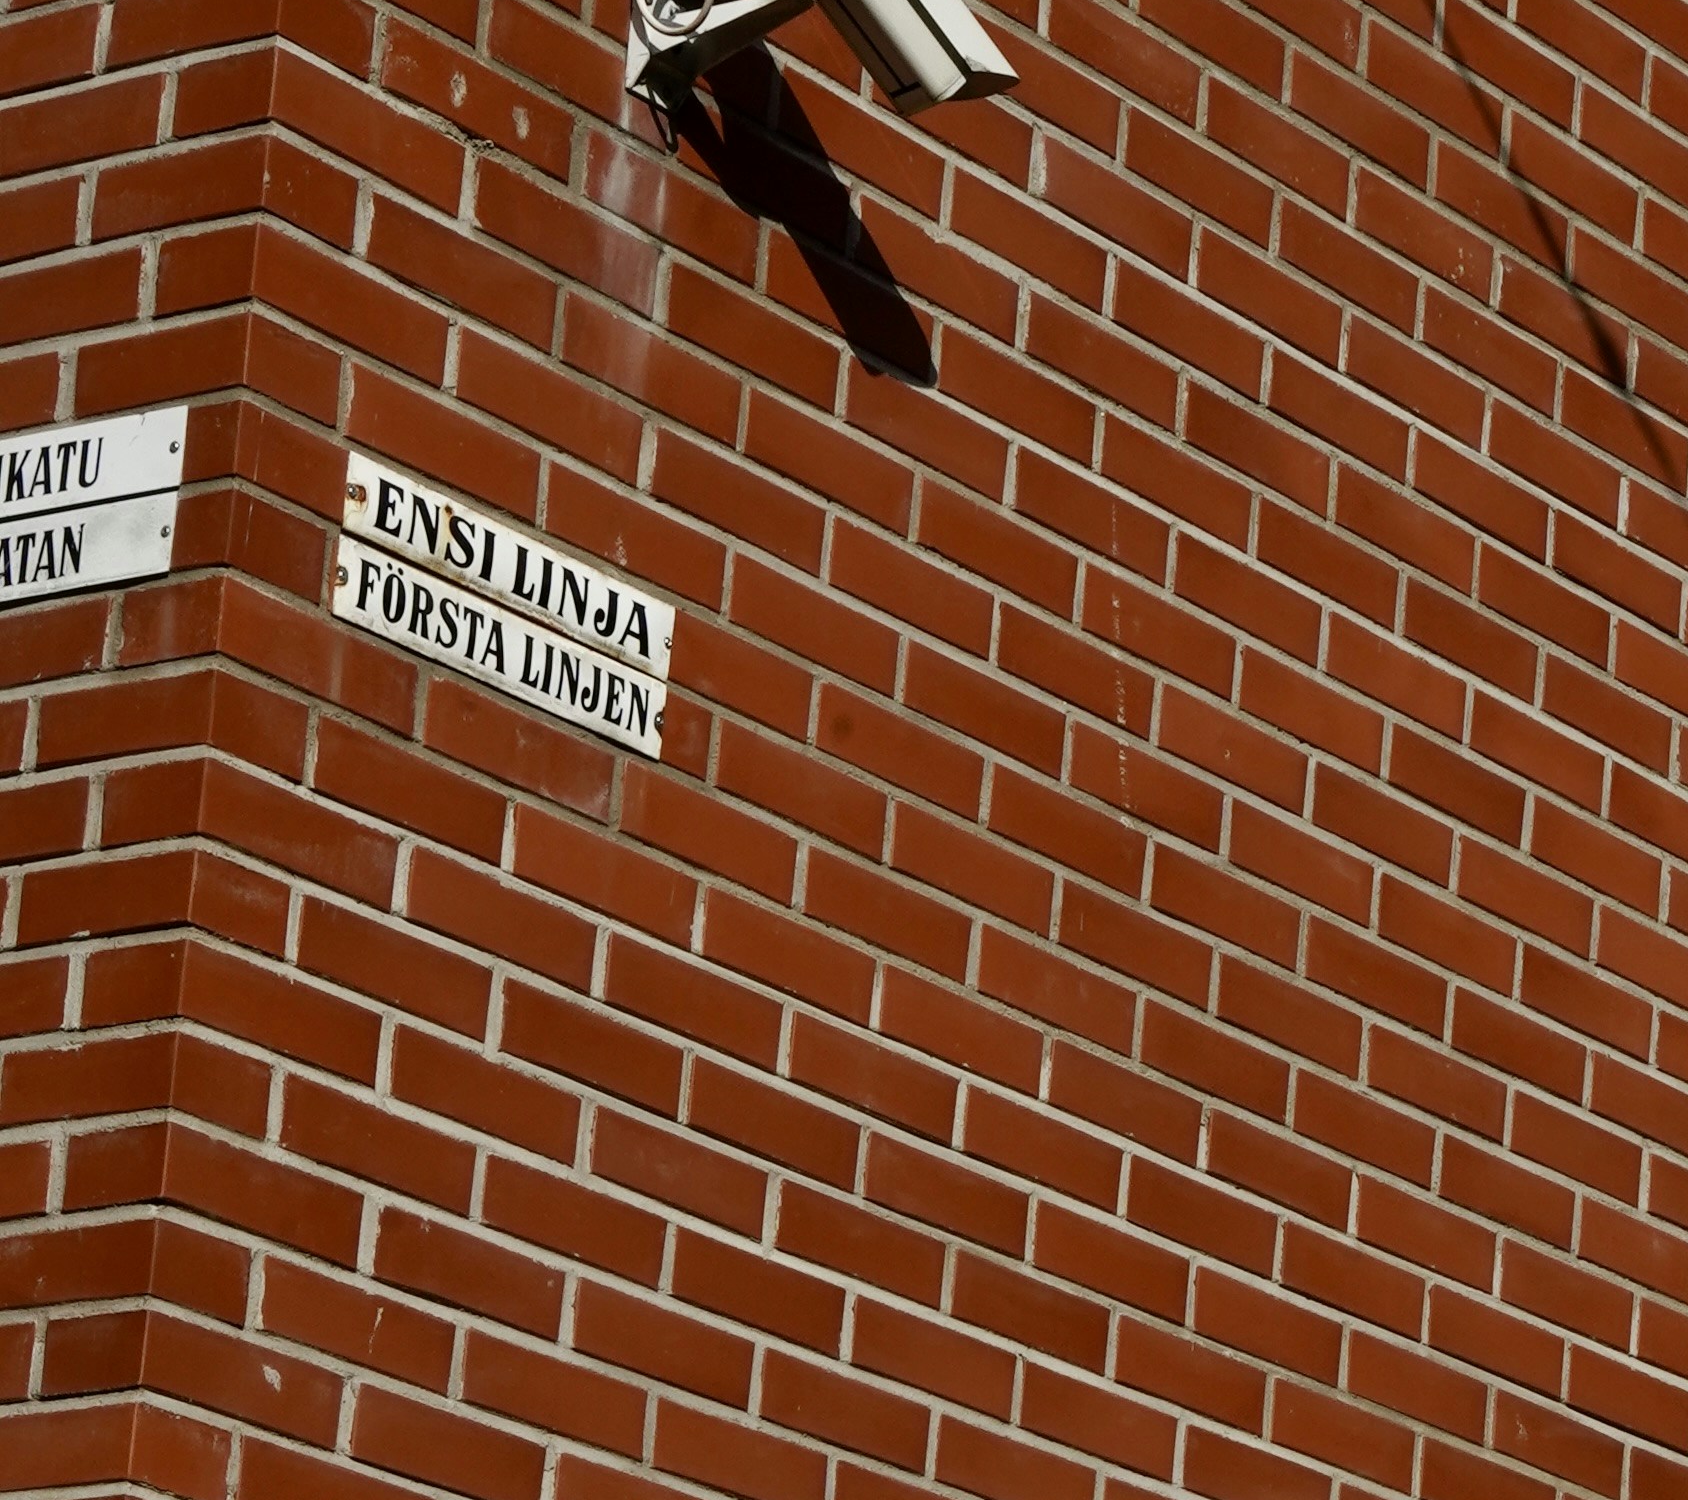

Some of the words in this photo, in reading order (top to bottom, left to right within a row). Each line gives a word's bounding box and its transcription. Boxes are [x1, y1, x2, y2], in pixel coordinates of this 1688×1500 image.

[0, 437, 104, 503] KATU
[356, 558, 506, 675] FÖRSTA
[520, 634, 650, 737] LINJEN
[373, 477, 496, 582] ENSI
[511, 543, 651, 659] LINJA
